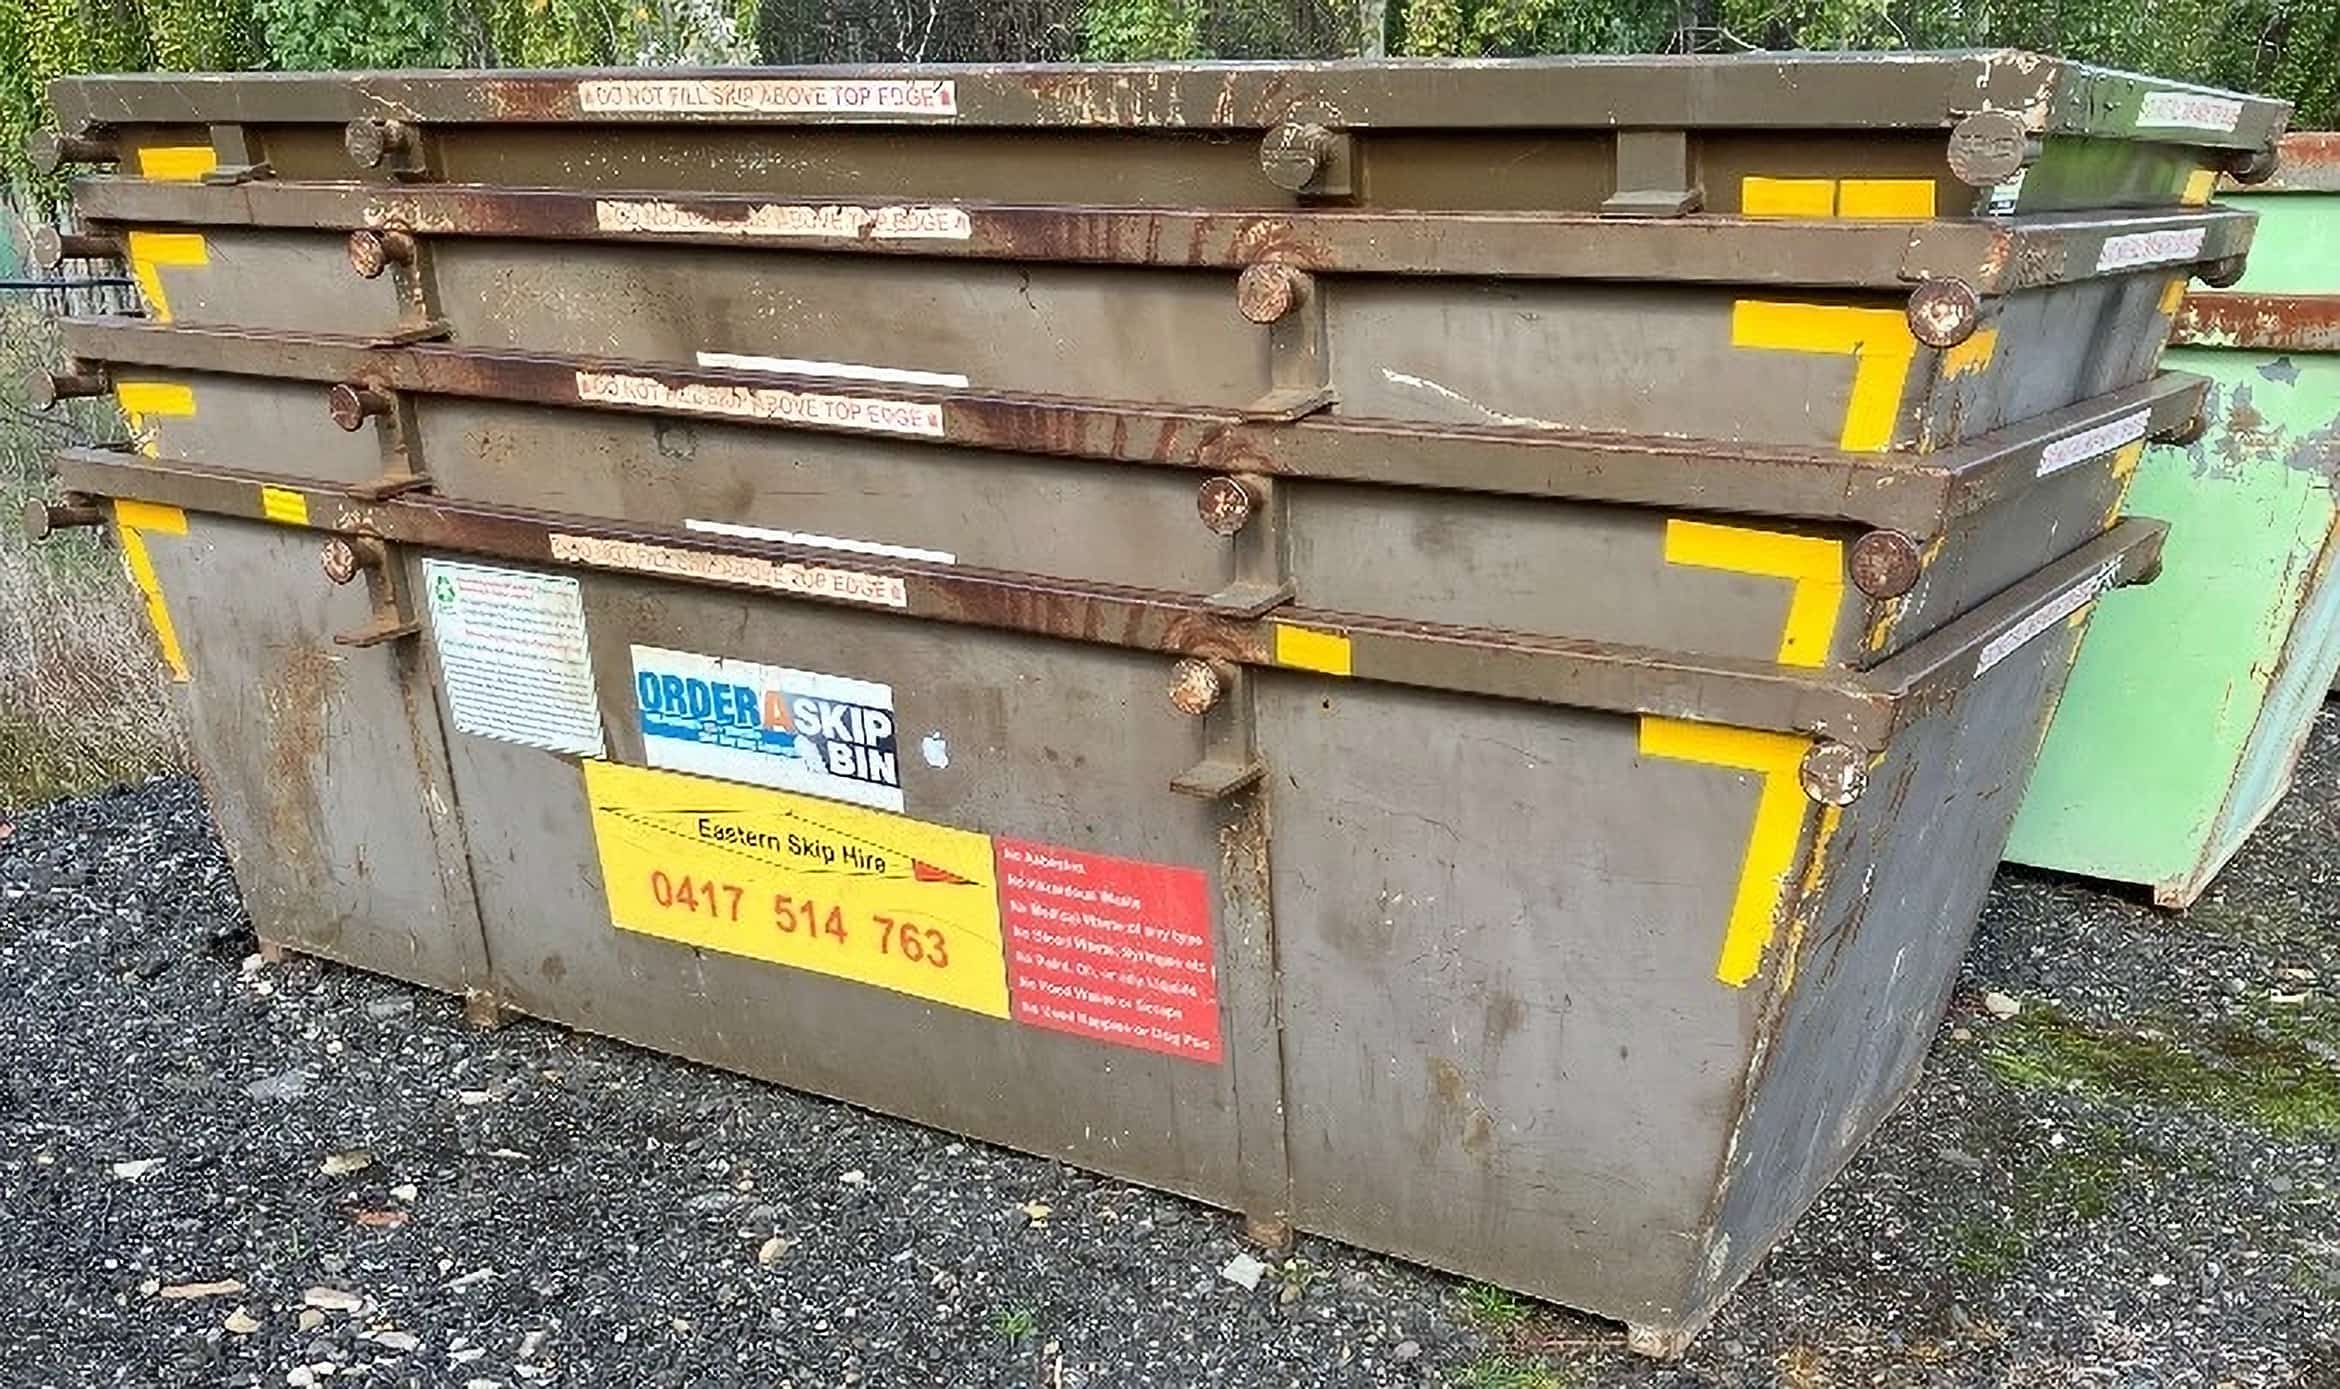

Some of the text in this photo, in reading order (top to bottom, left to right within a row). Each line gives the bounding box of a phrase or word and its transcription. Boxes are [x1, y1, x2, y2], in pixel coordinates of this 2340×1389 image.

[627, 86, 663, 105] NOT
[669, 87, 709, 106] FILL
[832, 86, 871, 106] TOP
[824, 400, 862, 420] TOP
[637, 670, 762, 727] ORDER
[762, 689, 795, 734] A
[794, 696, 893, 748] SKIP
[828, 738, 898, 787] BIN
[697, 816, 887, 875] Eastern Skip Hire
[650, 869, 950, 970] 0417 514 763
